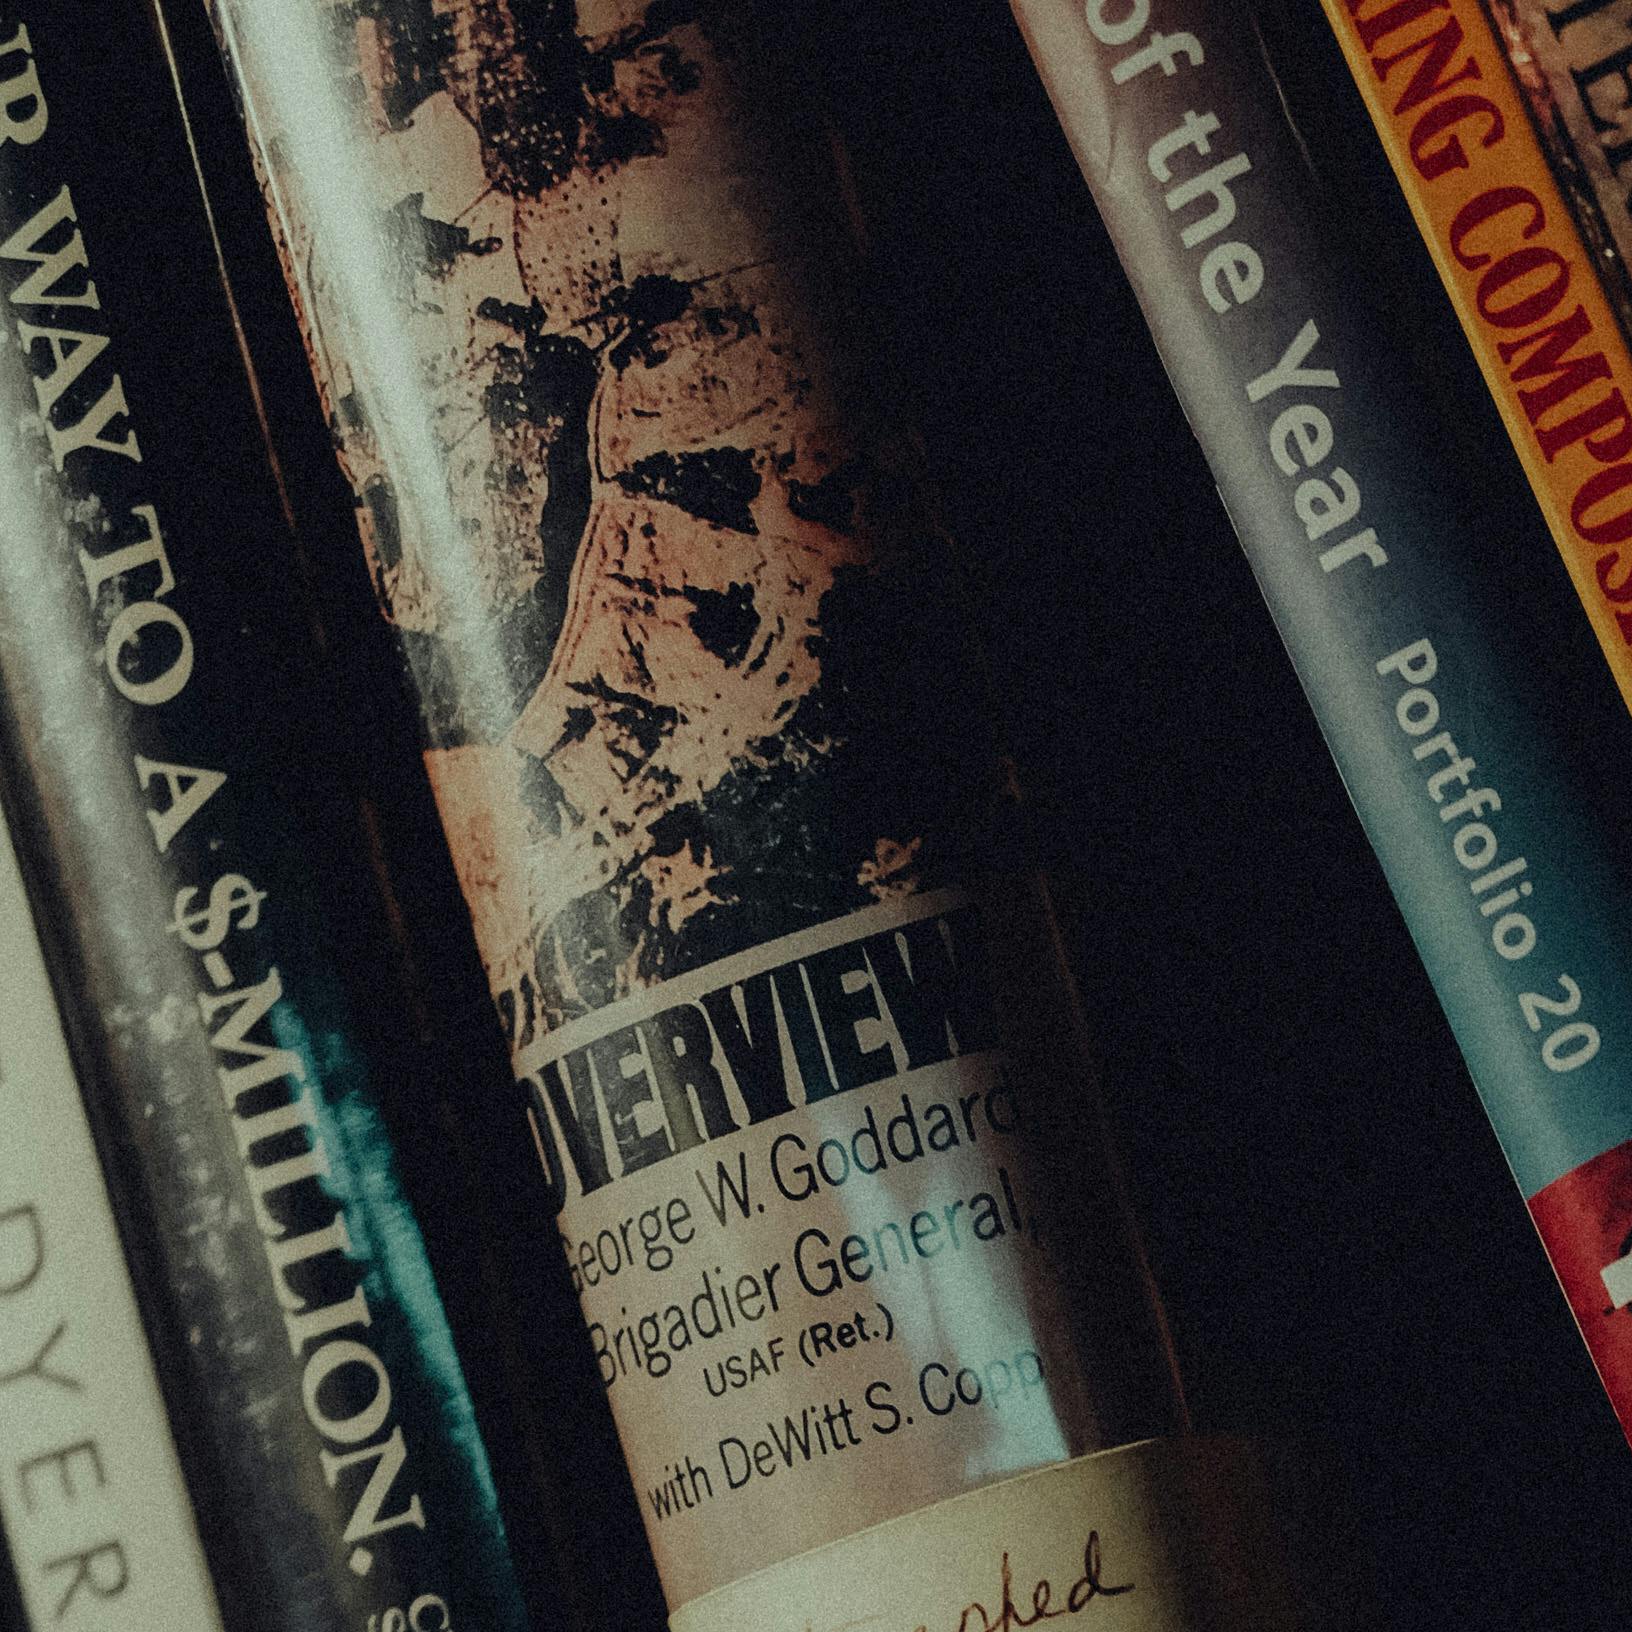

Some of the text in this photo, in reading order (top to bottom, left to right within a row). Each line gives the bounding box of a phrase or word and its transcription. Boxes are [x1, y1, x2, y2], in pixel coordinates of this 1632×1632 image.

[1348, 0, 1505, 181] ING
[0, 184, 142, 471] WAY
[78, 504, 195, 706] TO
[1085, 0, 1601, 1073] of the Year Portfolio 20
[133, 754, 229, 854] A
[166, 871, 428, 1578] $-MILLION.
[563, 1197, 695, 1294] George
[696, 1151, 765, 1227] W.
[0, 1203, 128, 1620] DYER
[586, 1260, 781, 1387] Brigadier
[703, 1303, 894, 1398] USAF (Ret.)
[647, 1455, 713, 1520] with
[719, 1398, 862, 1491] DeWitt
[864, 1381, 915, 1435] S.
